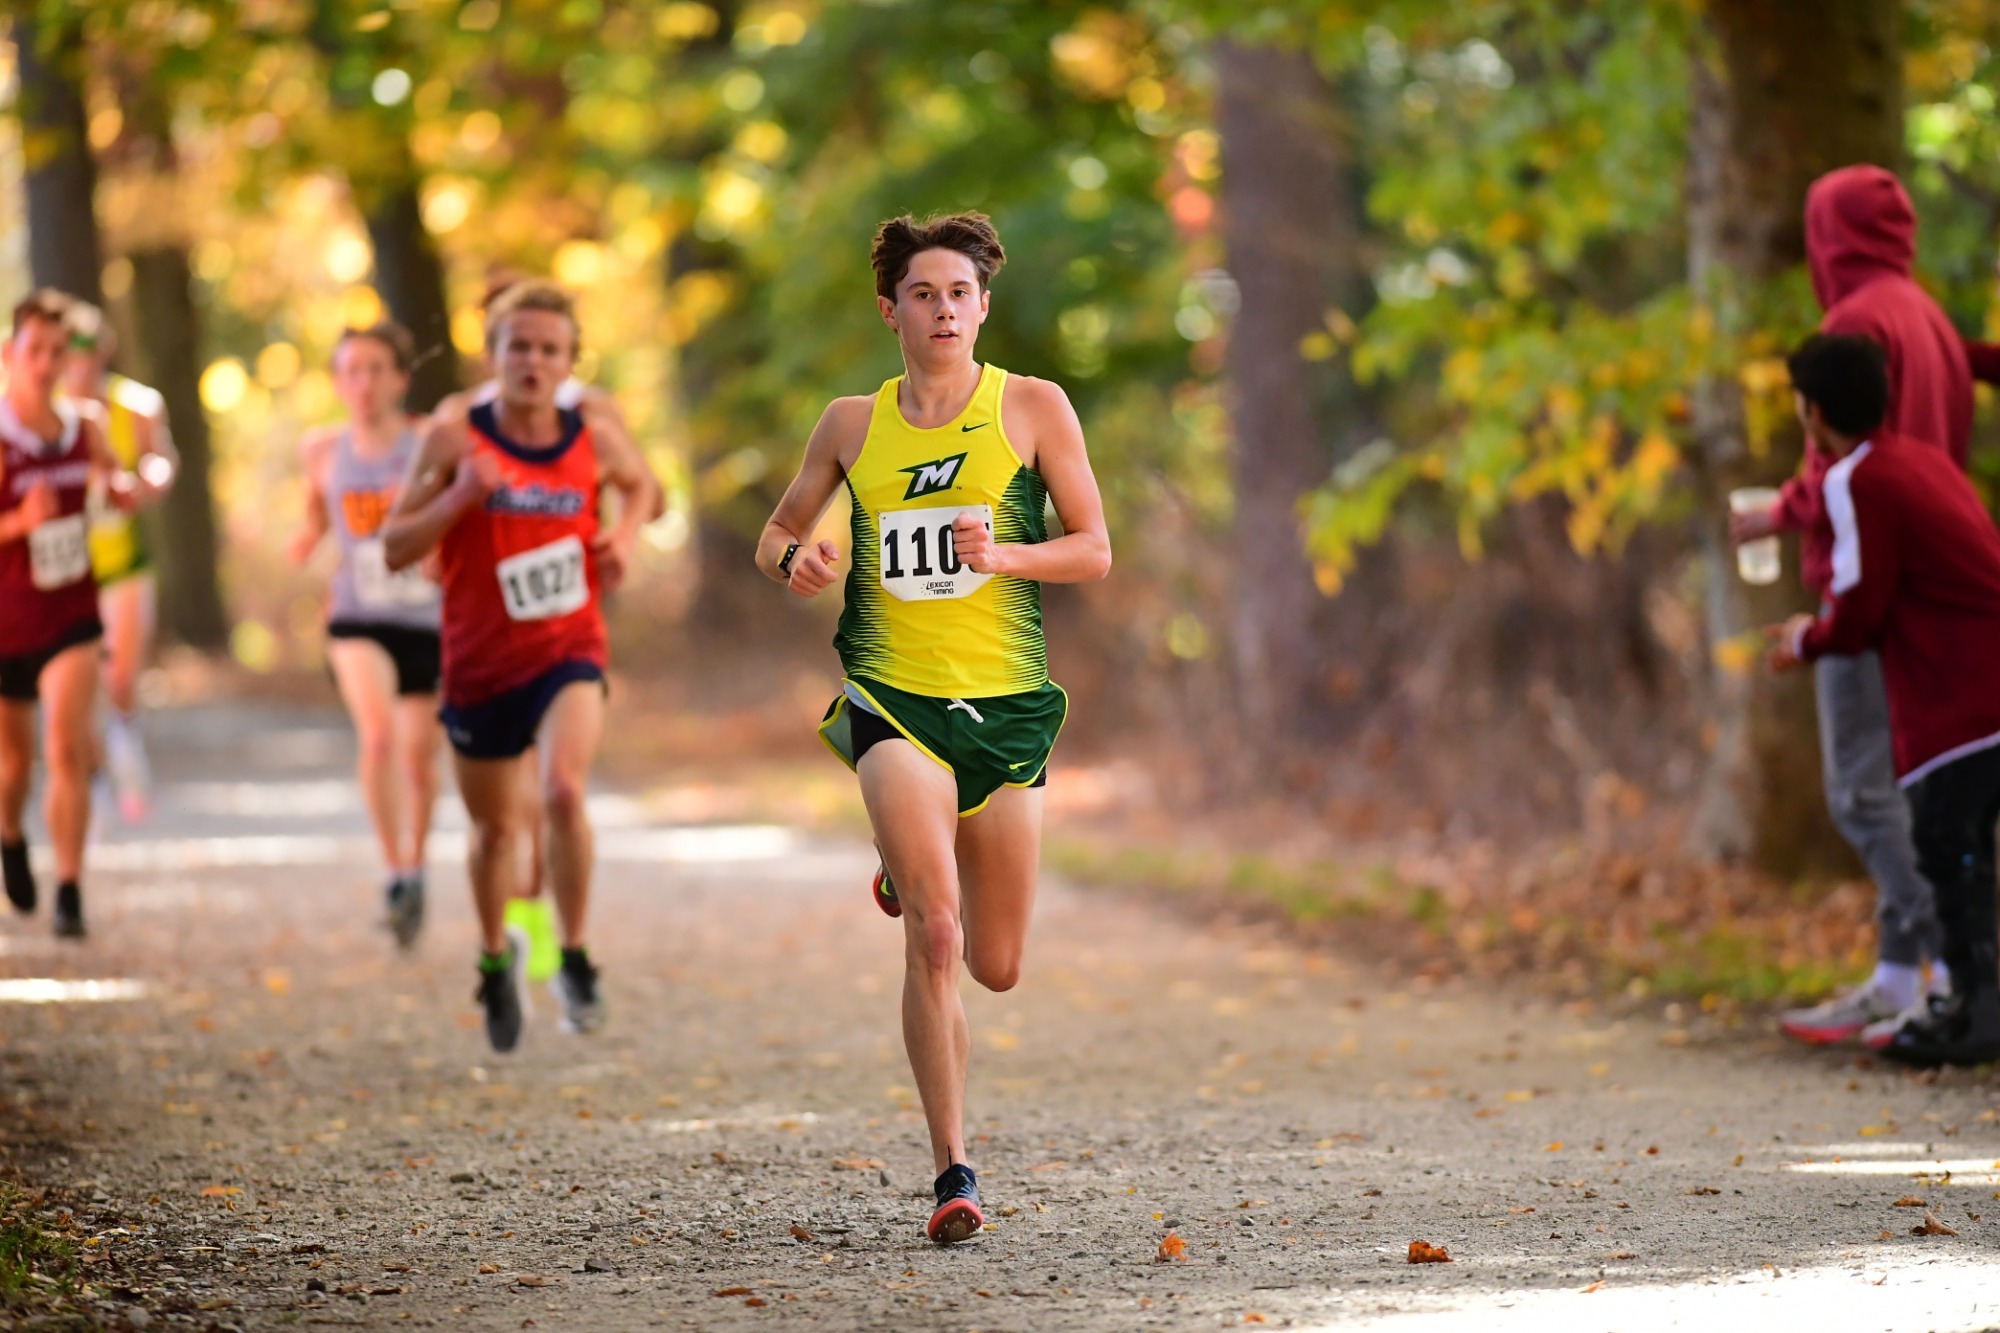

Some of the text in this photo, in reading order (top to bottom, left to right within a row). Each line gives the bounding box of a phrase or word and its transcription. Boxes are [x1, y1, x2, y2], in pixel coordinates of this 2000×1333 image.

[903, 454, 965, 499] M
[884, 522, 990, 579] 110
[926, 581, 954, 590] LEXICON
